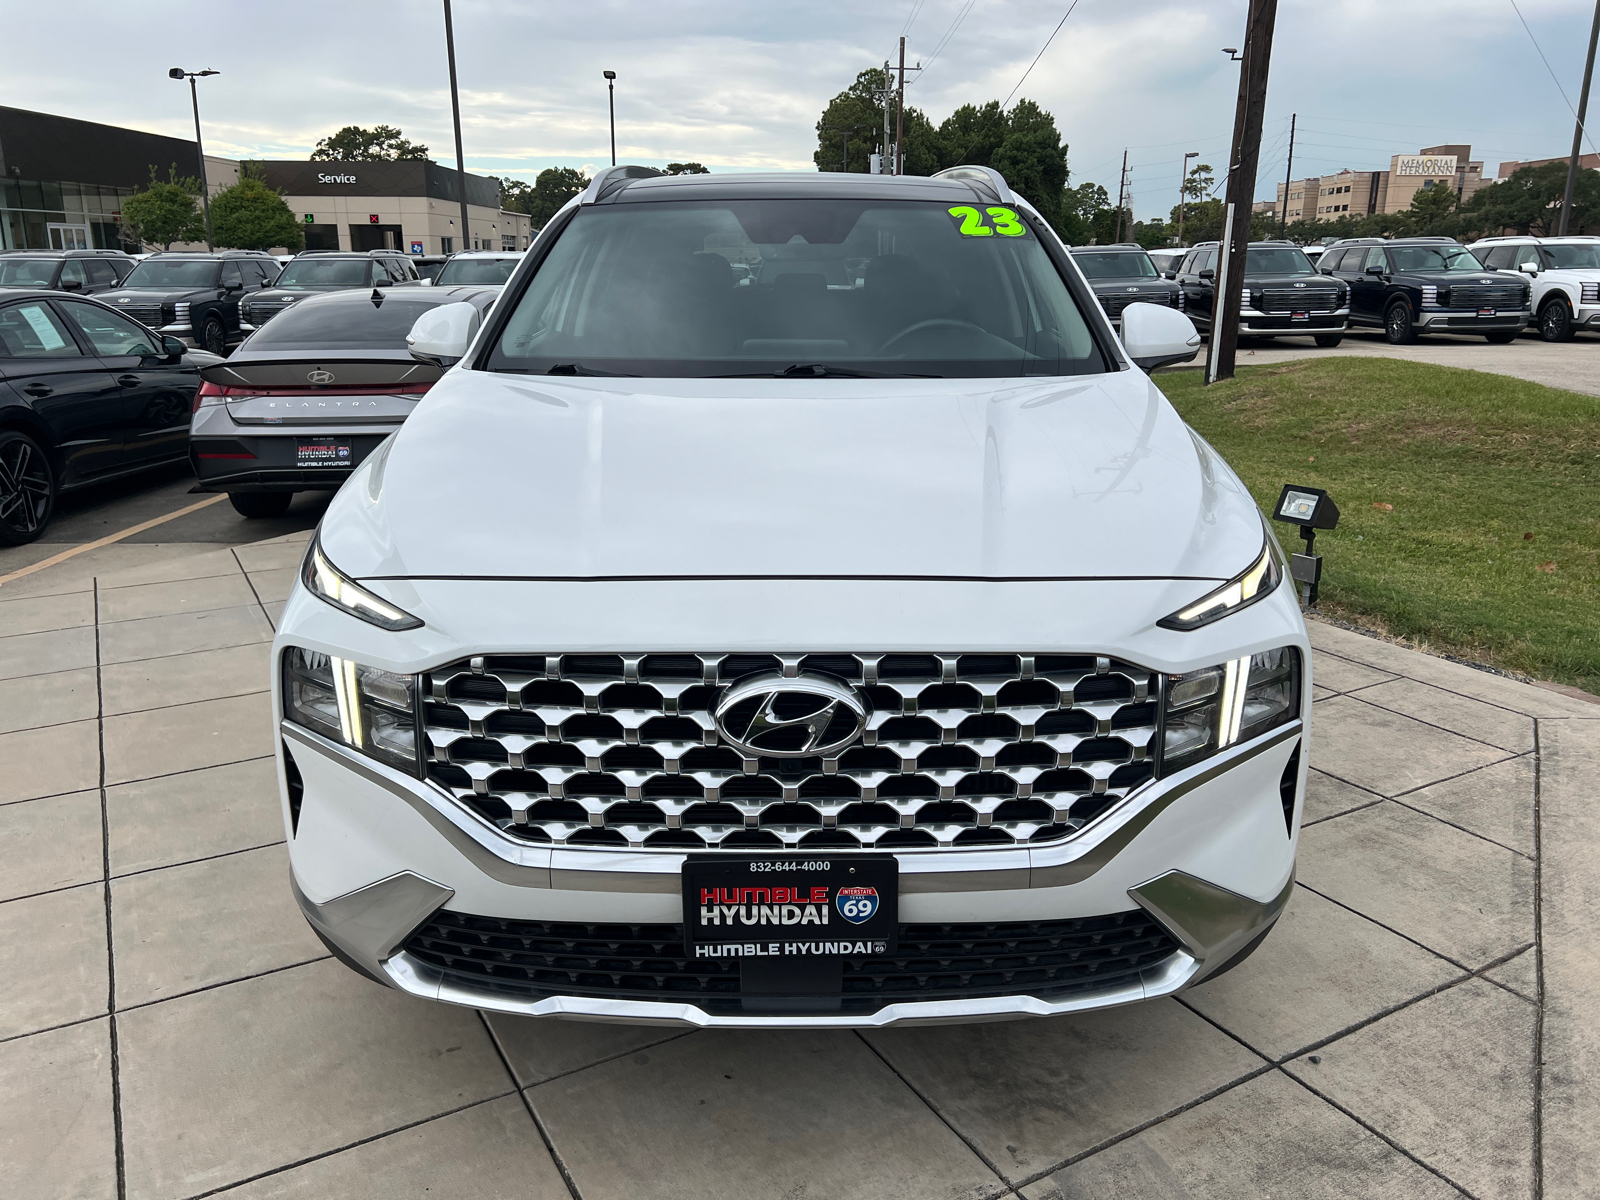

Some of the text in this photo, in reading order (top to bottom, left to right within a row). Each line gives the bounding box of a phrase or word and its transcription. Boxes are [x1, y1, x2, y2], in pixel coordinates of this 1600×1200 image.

[1400, 166, 1453, 175] HERMANN
[1401, 159, 1454, 167] MEMORIAL
[318, 173, 356, 183] Service
[948, 206, 1026, 237] 23
[749, 861, 831, 872] 832-644-4000
[700, 887, 829, 904] HUMBLE
[700, 904, 829, 926] HYUNDAI
[843, 900, 873, 917] 69
[695, 944, 780, 958] HUMBLE
[784, 942, 872, 955] HYUNDAI
